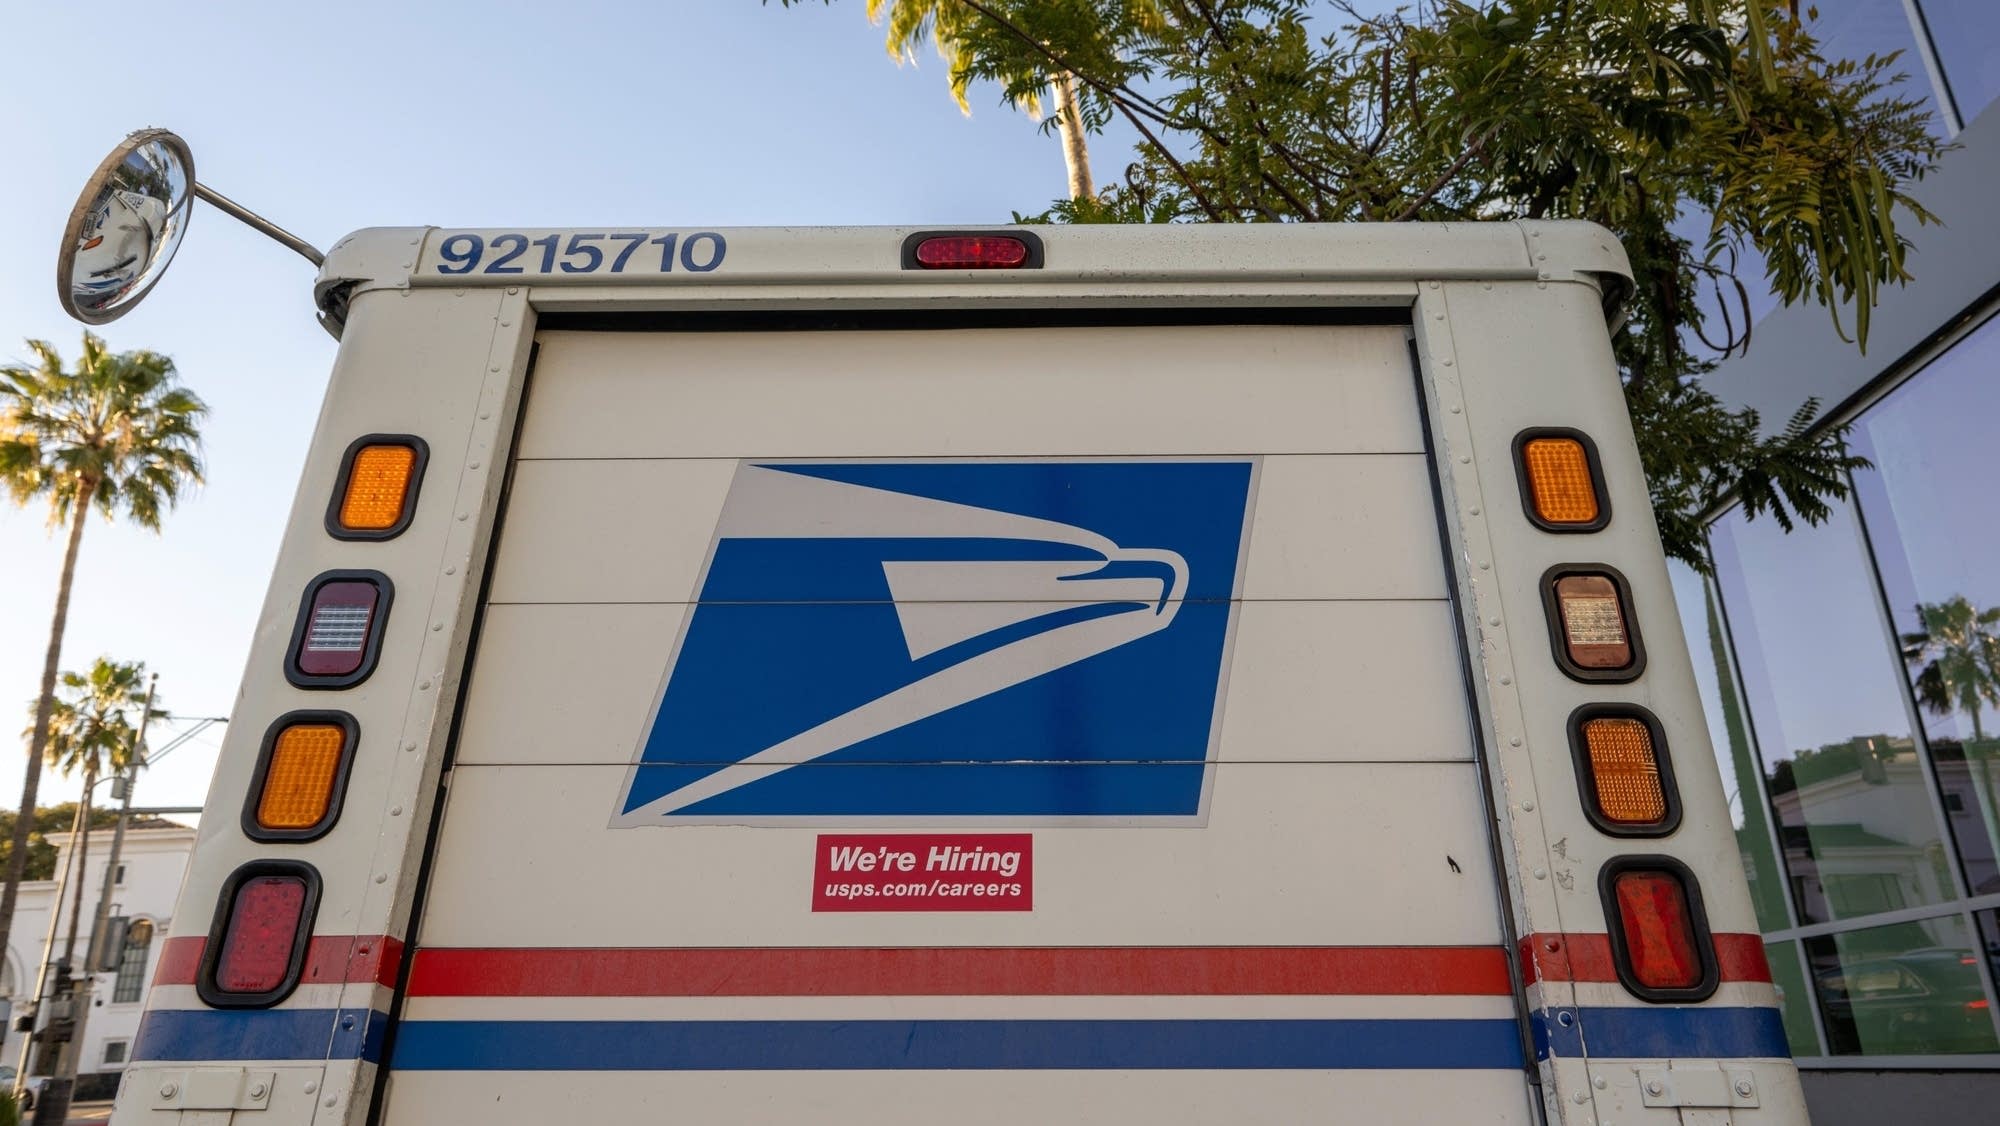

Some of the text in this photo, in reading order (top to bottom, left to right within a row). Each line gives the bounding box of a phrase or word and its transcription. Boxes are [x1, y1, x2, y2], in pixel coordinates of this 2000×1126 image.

[437, 231, 727, 274] 9215710
[829, 846, 1021, 877] We’re Hiring
[825, 879, 1022, 900] usps.com/careers
